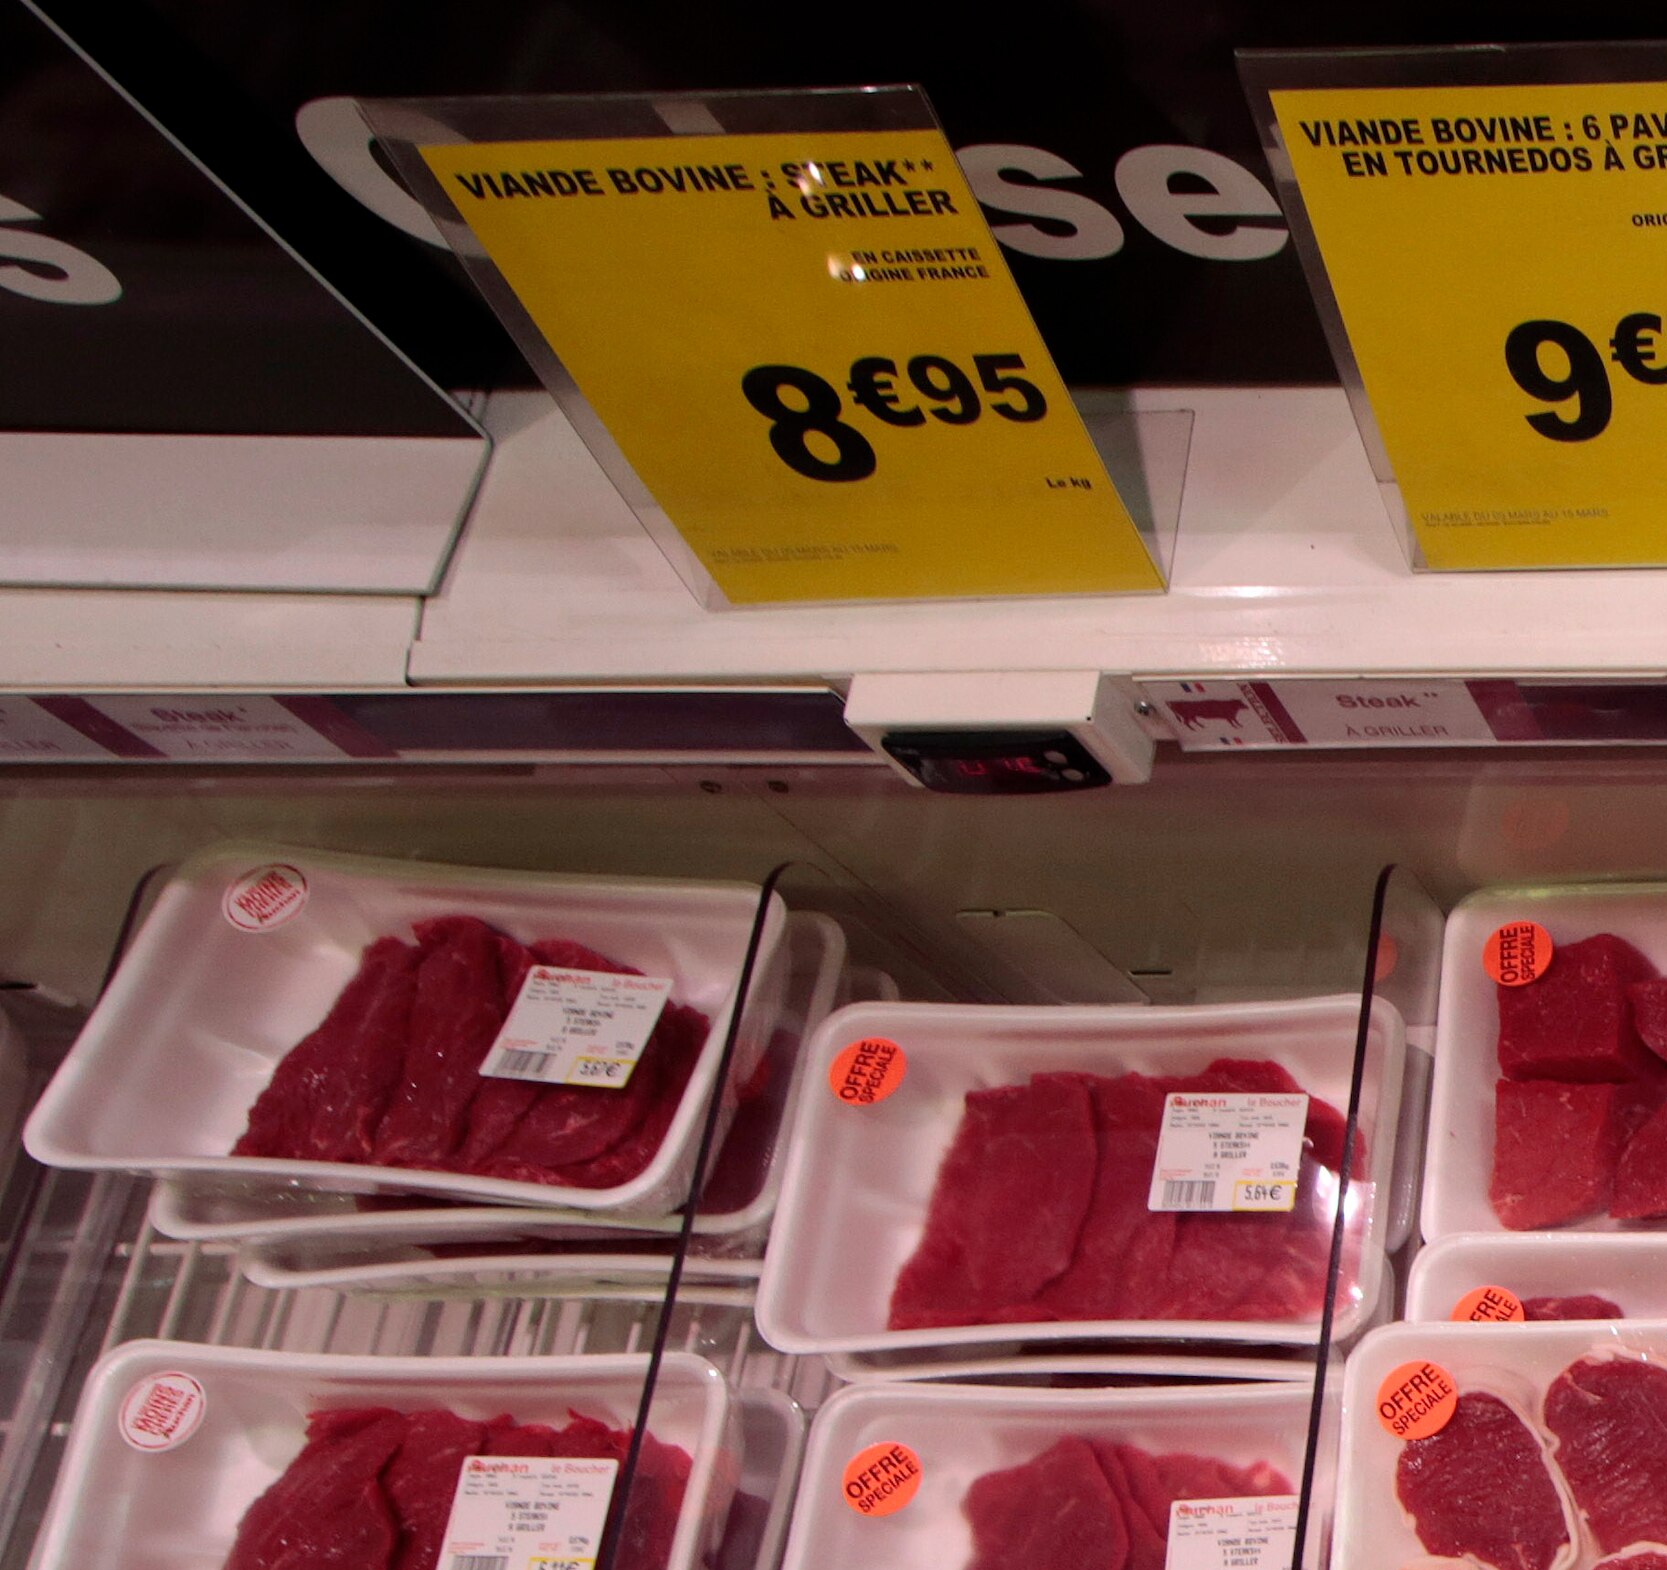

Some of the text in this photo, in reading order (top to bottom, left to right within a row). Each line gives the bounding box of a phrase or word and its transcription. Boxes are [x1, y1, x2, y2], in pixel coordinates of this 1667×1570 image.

[1300, 116, 1422, 149] VIANDE
[1431, 113, 1557, 144] BOVINE
[1580, 113, 1601, 141] 6
[455, 168, 605, 200] VIANDE
[605, 163, 753, 195] BOVINE
[1343, 147, 1388, 178] EN
[1392, 144, 1593, 176] TOURNEDOS
[1603, 138, 1625, 171] À
[766, 189, 958, 221] À GRILLER
[852, 247, 980, 265] EN CAISSETTE
[917, 264, 990, 281] FRANCE
[741, 353, 1048, 483] 8€95
[1363, 724, 1449, 737] GRILLER
[1500, 926, 1519, 983] OFFRE
[1520, 924, 1536, 981] SPECIALE
[840, 1041, 880, 1101] OFFRE
[858, 1044, 897, 1104] SPECIALE
[1245, 1185, 1282, 1201] 5,64€
[1379, 1363, 1440, 1422] OFFRE
[1392, 1380, 1452, 1436] SPECIALE
[846, 1445, 908, 1499] OFFRE
[858, 1463, 920, 1513] SPECIALE
